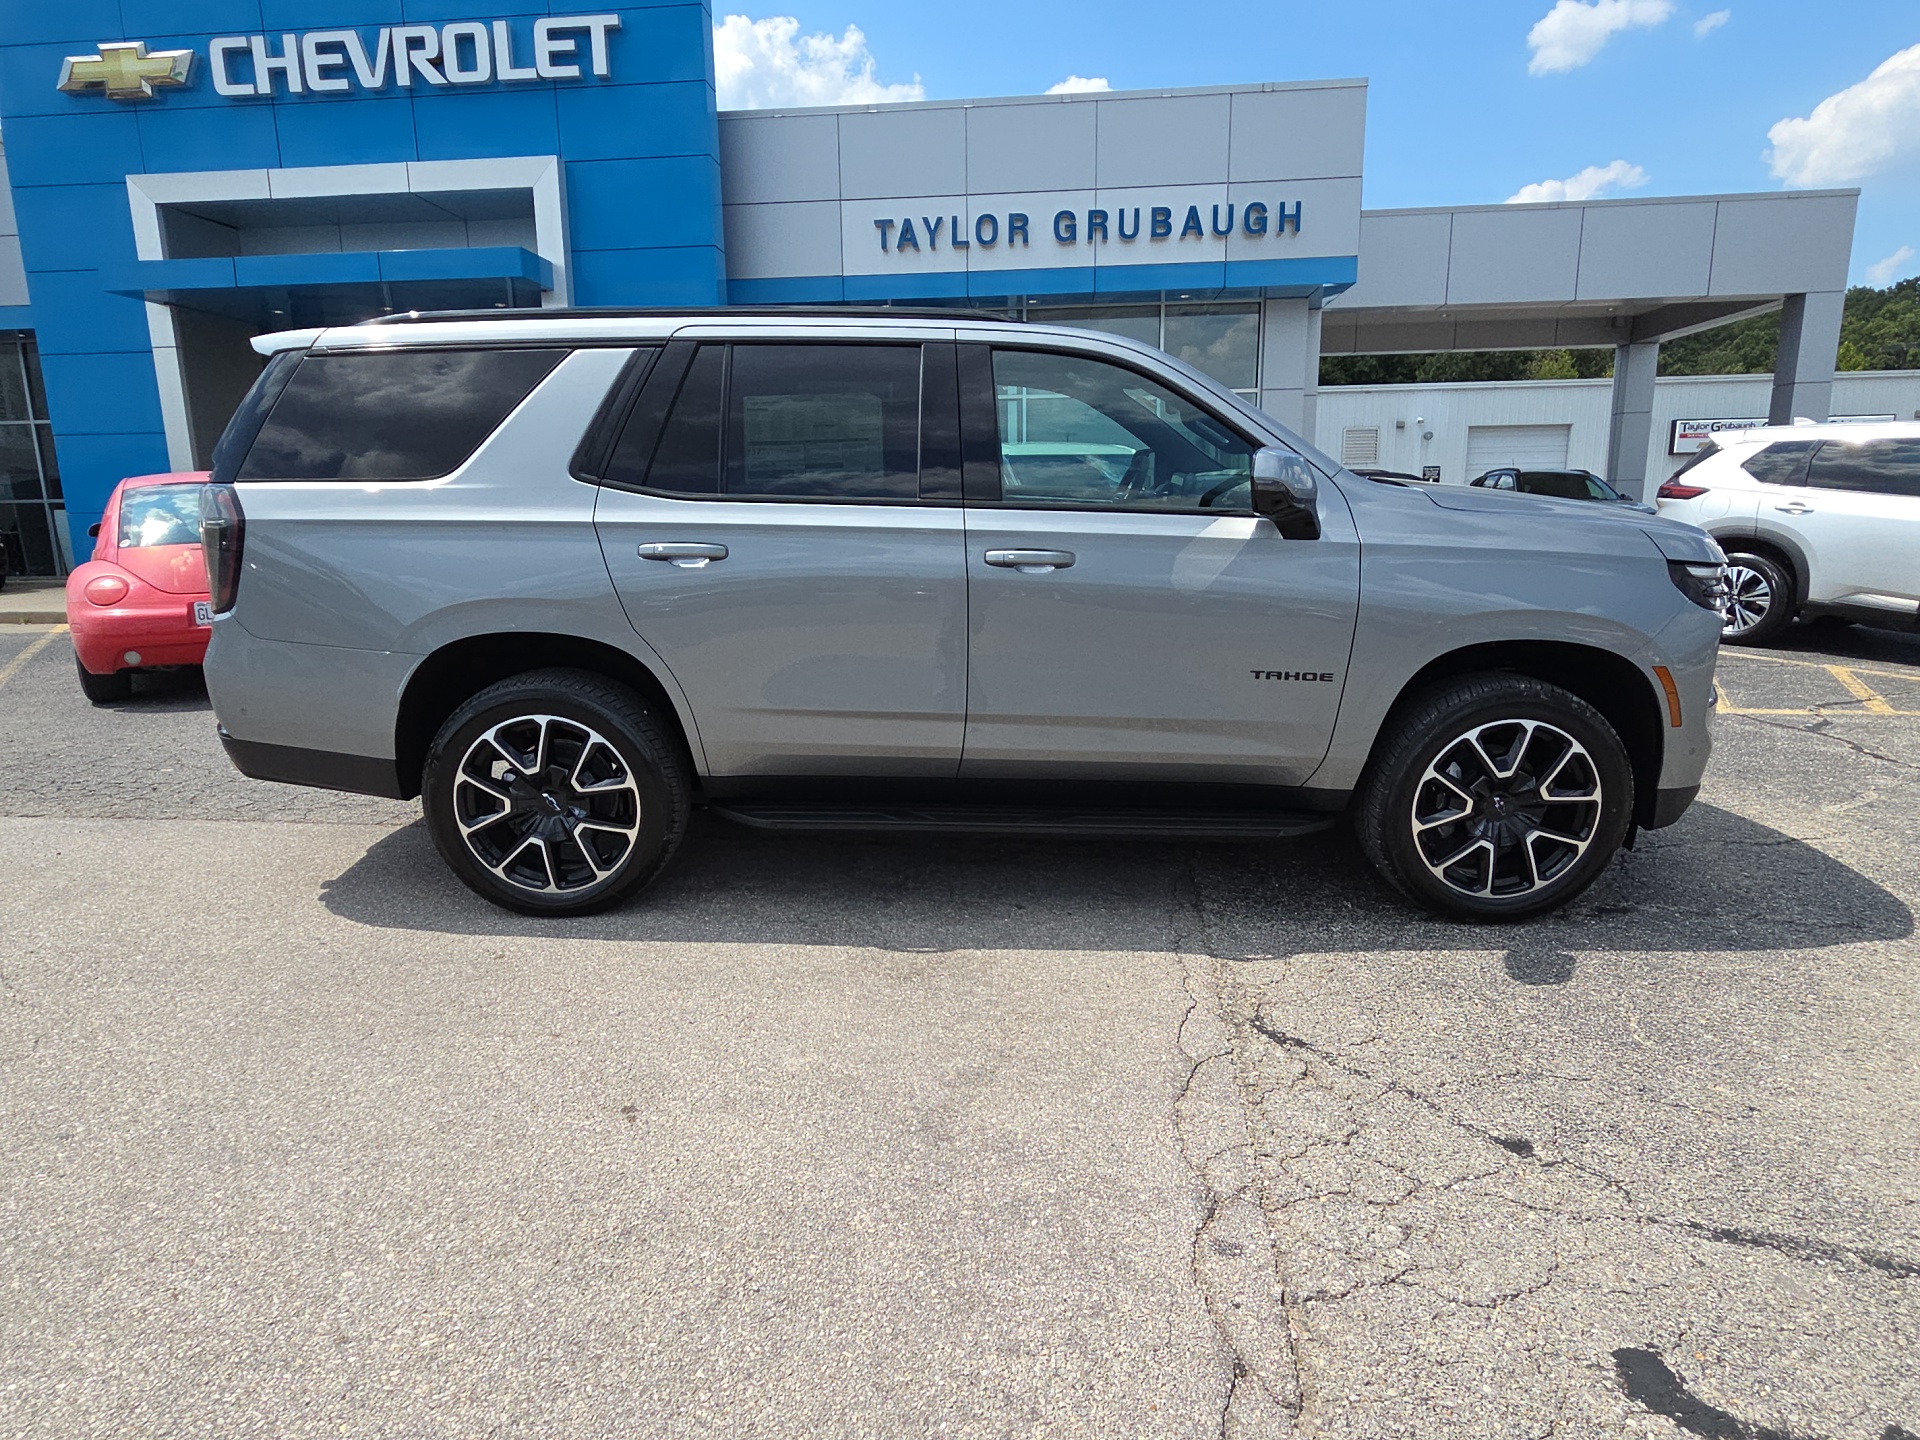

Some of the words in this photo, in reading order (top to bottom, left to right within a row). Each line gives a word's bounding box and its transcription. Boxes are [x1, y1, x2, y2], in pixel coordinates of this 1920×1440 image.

[209, 14, 620, 97] CHEVROLET
[874, 212, 1029, 251] TAYLOR
[1053, 200, 1302, 244] GRUBAUGH
[1681, 422, 1709, 432] Taylor
[1250, 670, 1334, 682] TAHOE
